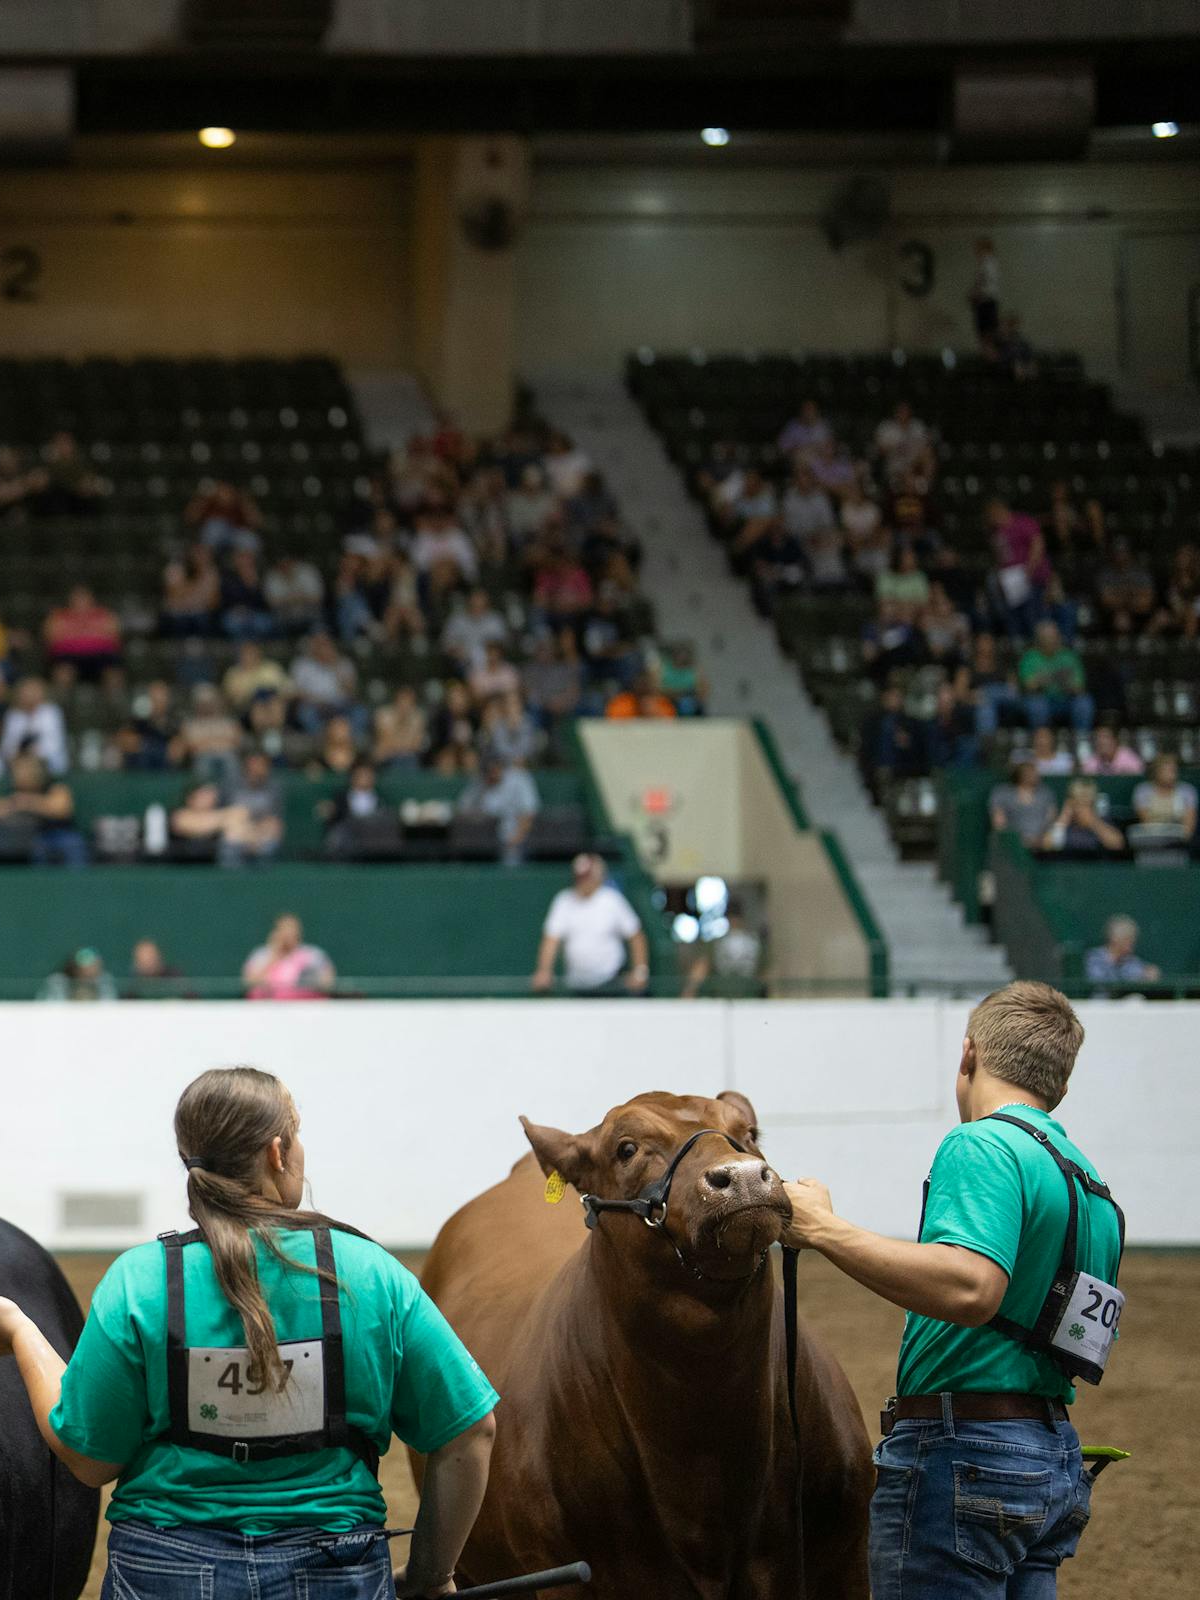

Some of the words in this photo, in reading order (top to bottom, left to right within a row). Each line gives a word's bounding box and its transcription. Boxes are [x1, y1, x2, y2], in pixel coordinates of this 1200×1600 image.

[0, 245, 41, 304] 2
[899, 240, 936, 298] 3
[218, 1359, 294, 1396] 497
[336, 1533, 373, 1545] SMART
